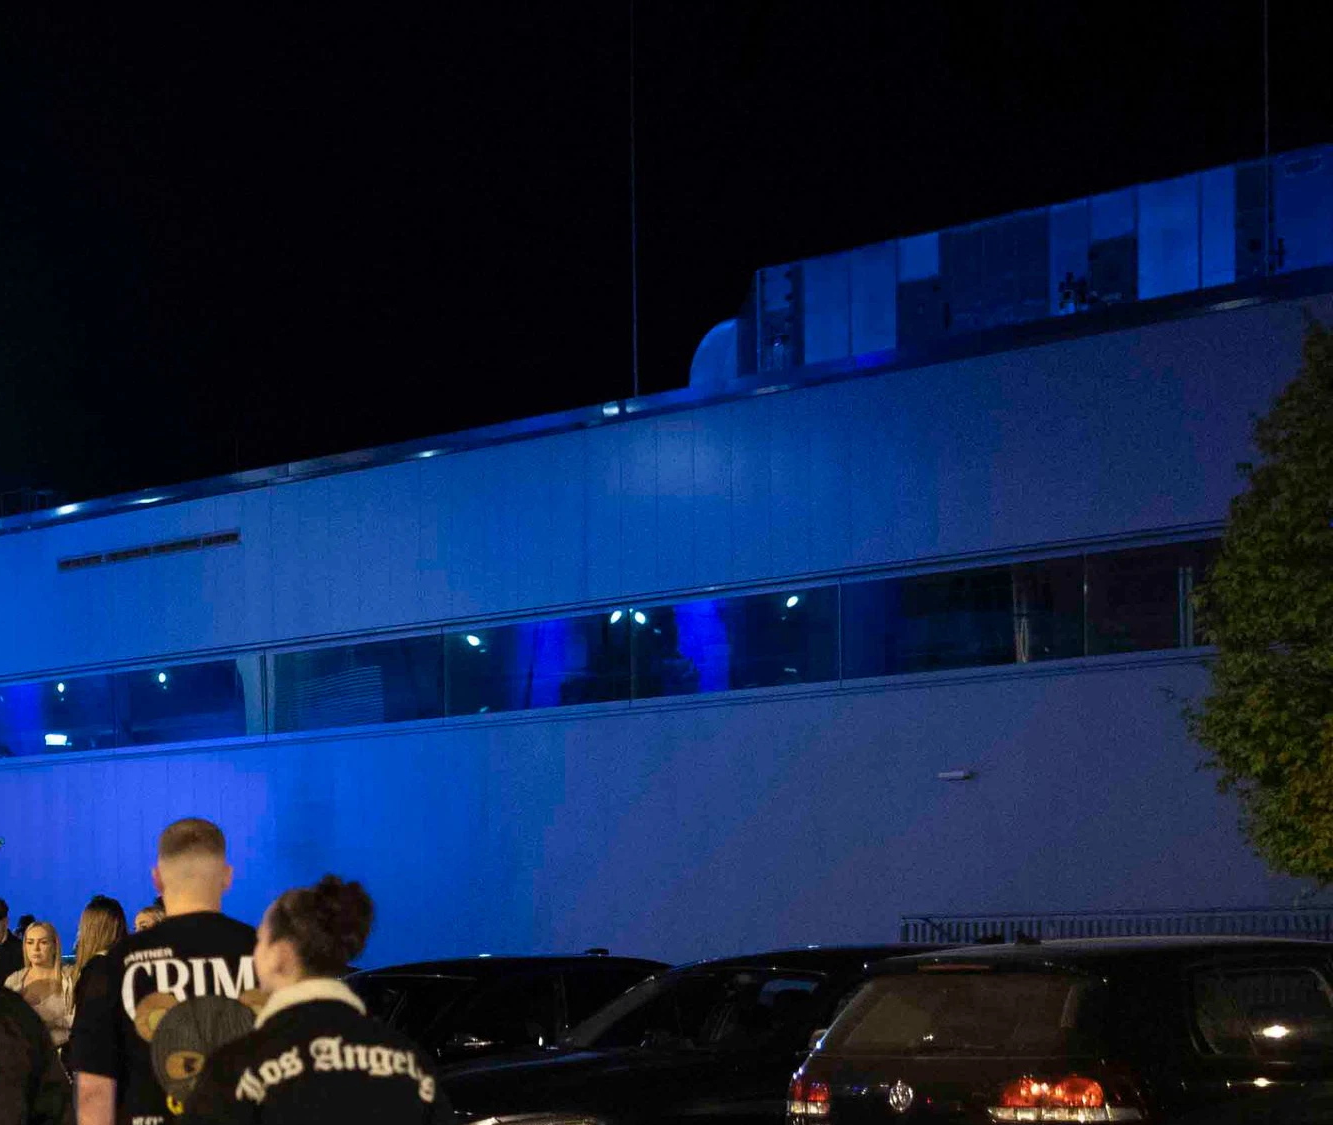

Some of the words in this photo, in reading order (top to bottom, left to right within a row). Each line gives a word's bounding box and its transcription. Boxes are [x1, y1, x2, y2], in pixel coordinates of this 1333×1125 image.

[120, 954, 256, 1022] CRIM
[123, 946, 174, 967] PARTNER
[234, 1046, 306, 1105] Los
[308, 1034, 437, 1104] Angels
